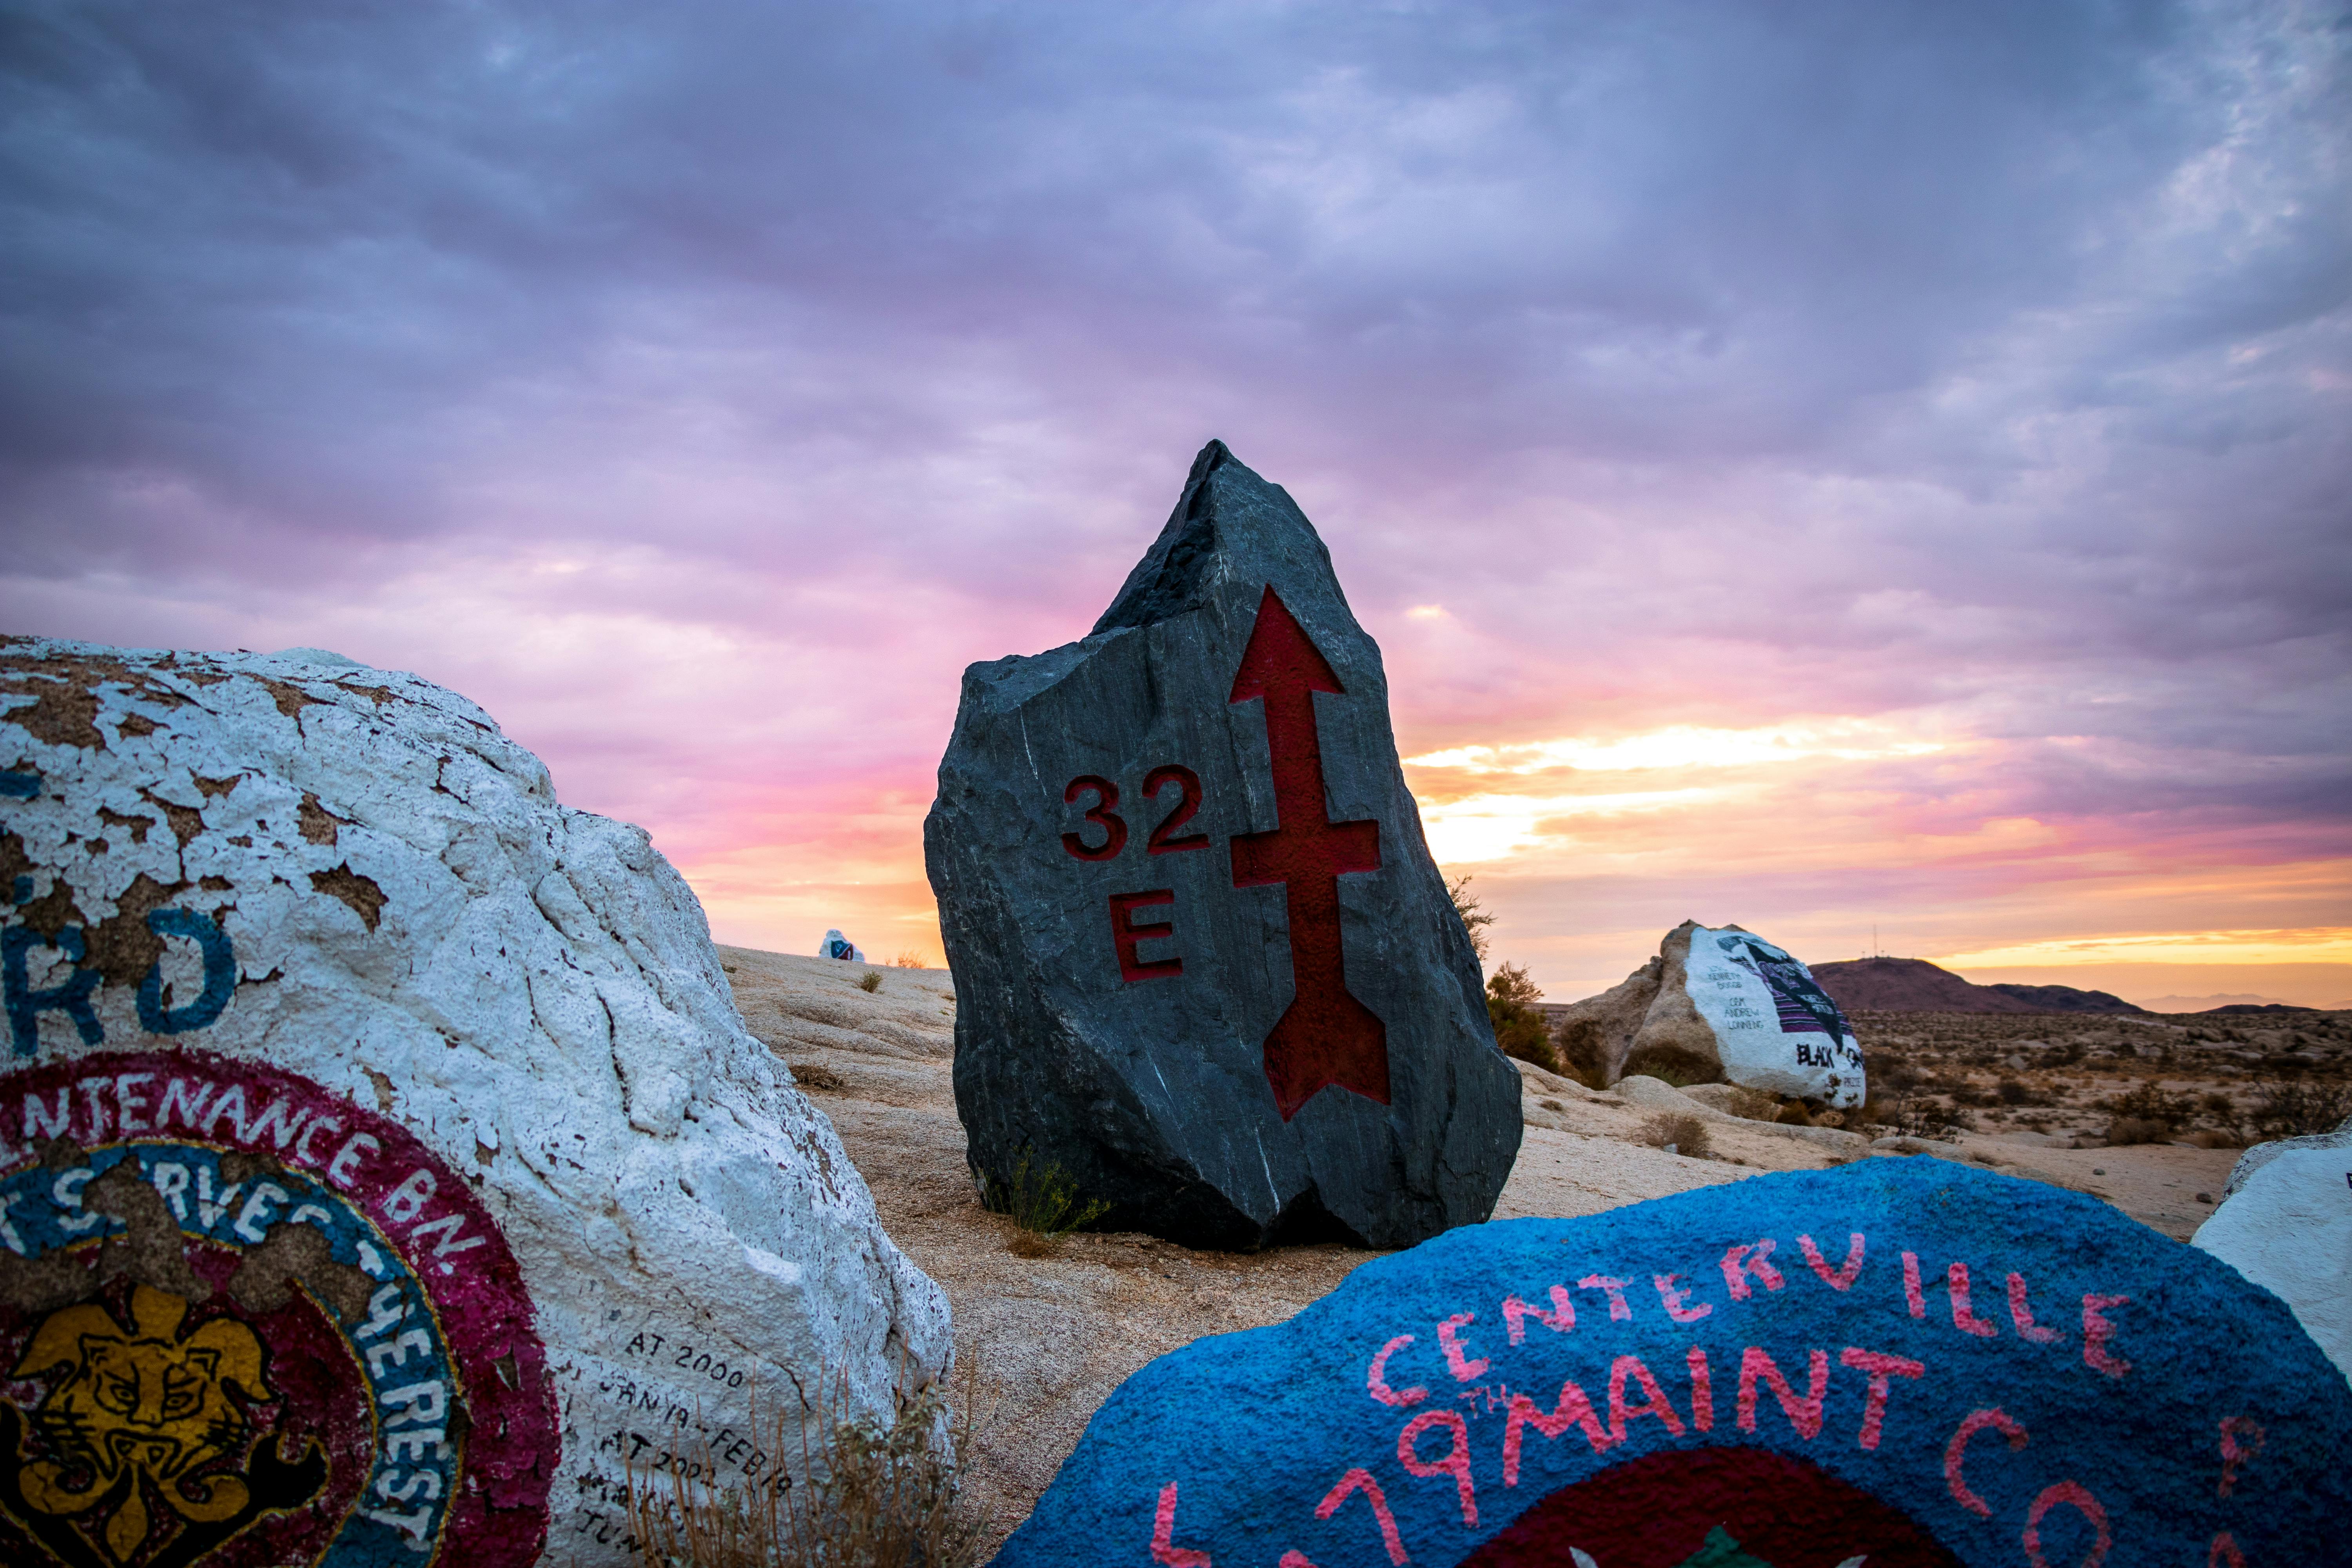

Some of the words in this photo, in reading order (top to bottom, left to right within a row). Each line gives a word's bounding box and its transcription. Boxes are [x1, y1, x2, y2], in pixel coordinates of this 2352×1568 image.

[1062, 764, 1210, 862] 32
[1109, 888, 1183, 982] E
[1725, 1008, 1759, 1018] ANDREW
[1797, 1044, 1835, 1069] BLACK
[53, 1160, 331, 1243] SRVE
[625, 1332, 666, 1357] AT
[675, 1345, 743, 1388] 2000
[1367, 1232, 2132, 1408] CENTERVILLE
[710, 1428, 767, 1477] FEB
[1502, 1344, 1926, 1488] MAINT
